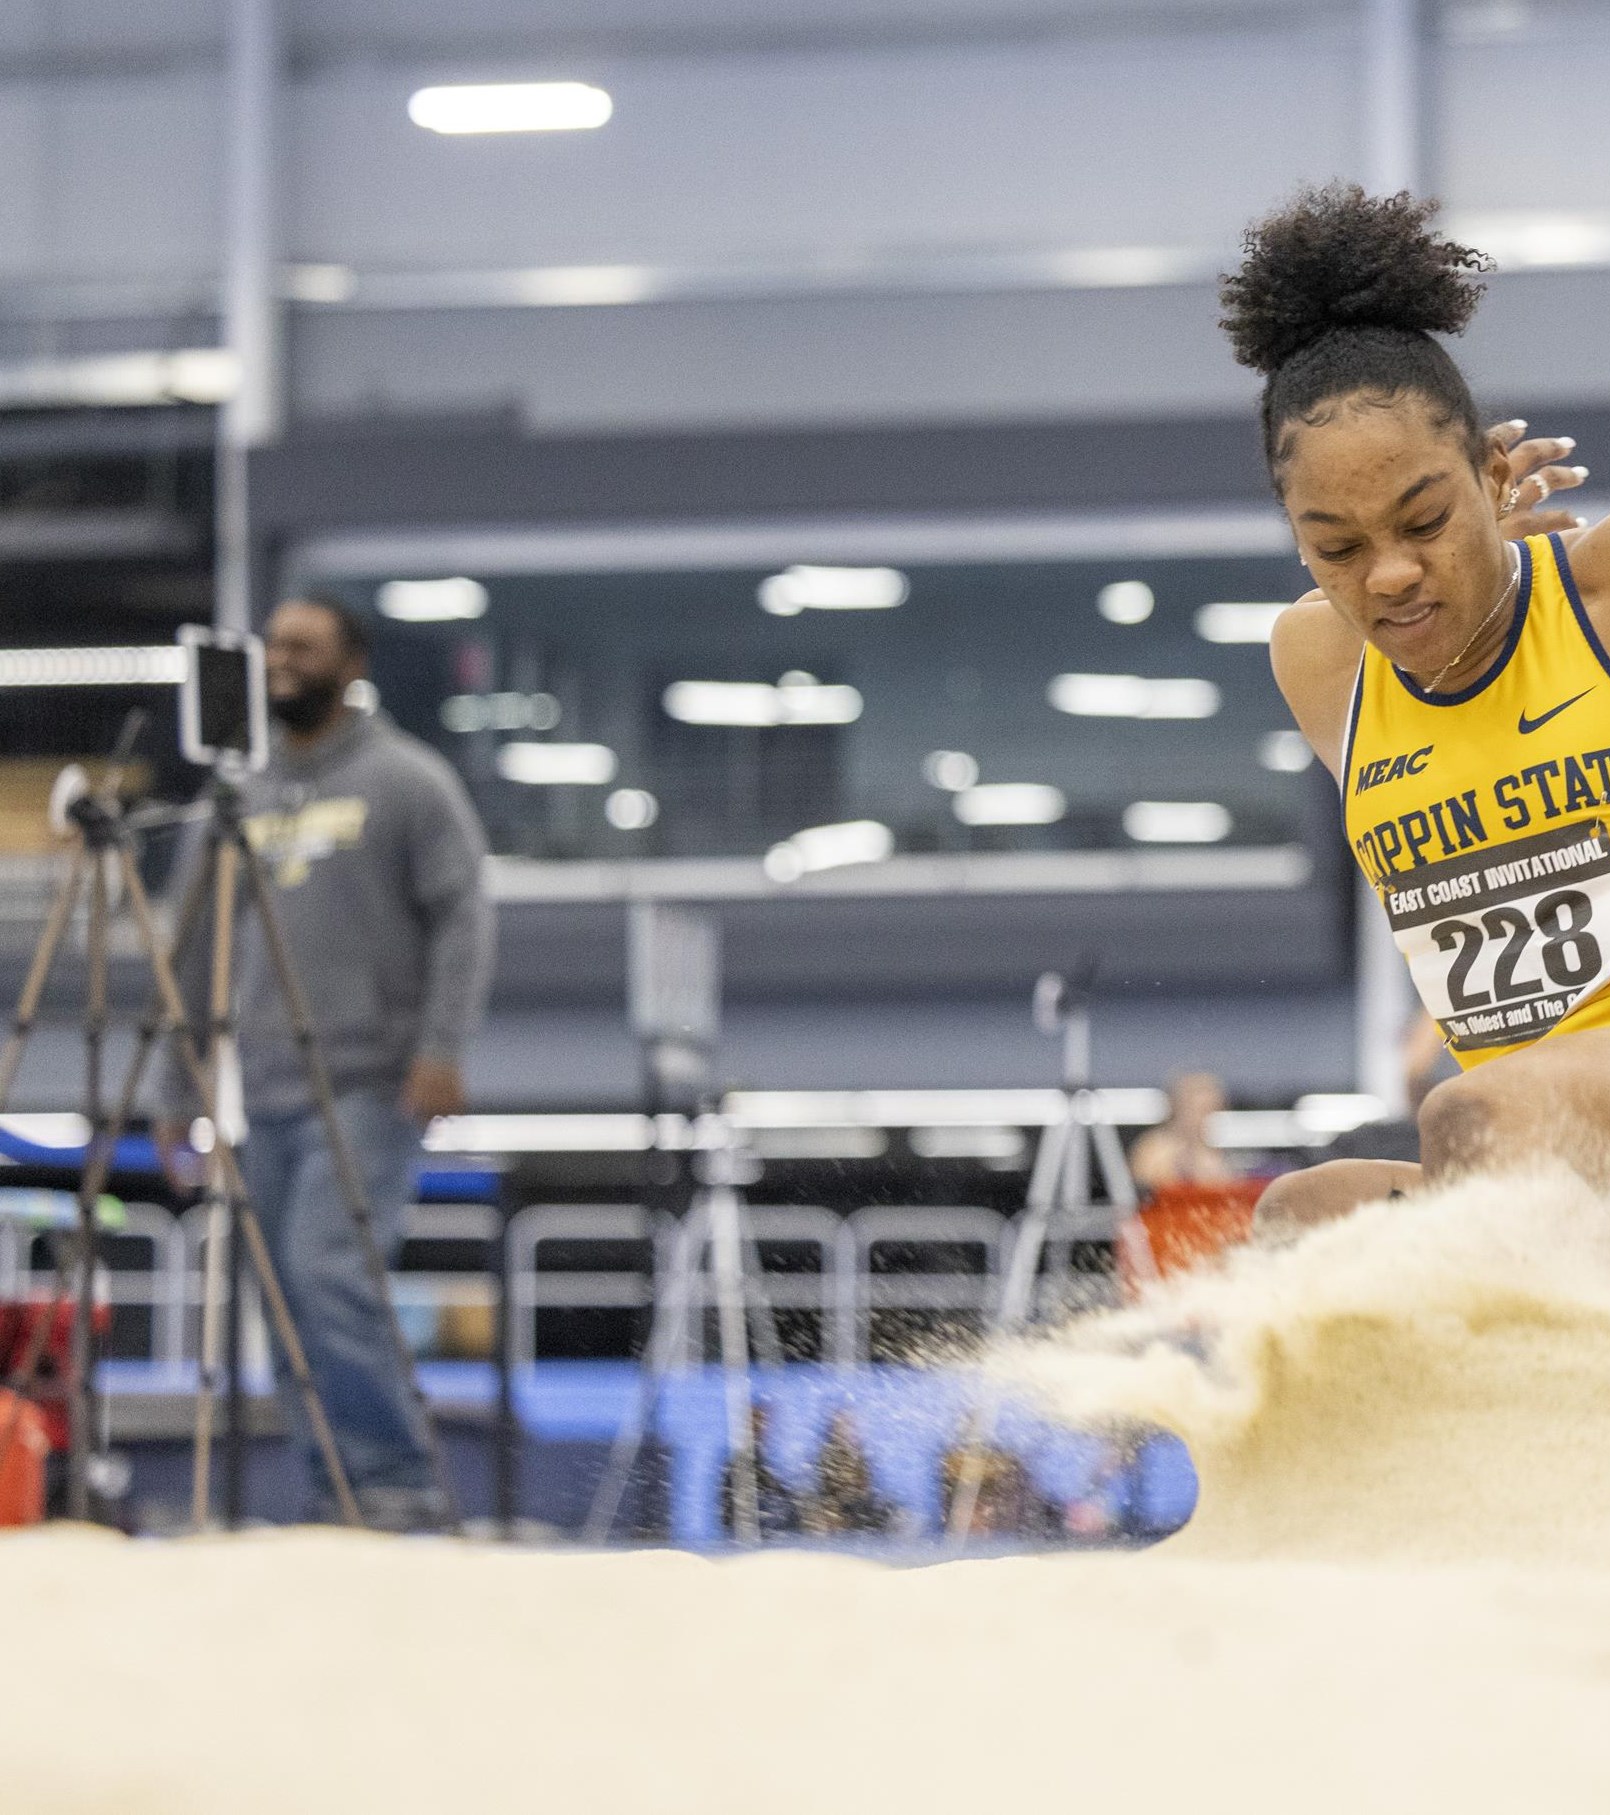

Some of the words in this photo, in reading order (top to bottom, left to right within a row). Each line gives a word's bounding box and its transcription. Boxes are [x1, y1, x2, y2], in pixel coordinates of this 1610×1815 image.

[1355, 744, 1434, 796] MEAC
[1389, 887, 1426, 915] EAST
[1426, 872, 1482, 906] COAST
[1483, 838, 1608, 890] INVITATIONAL
[1431, 889, 1602, 1012] 228
[1446, 1019, 1470, 1037] The
[1467, 1012, 1506, 1036] Oldest
[1505, 1003, 1533, 1028] and
[1533, 999, 1565, 1020] The
